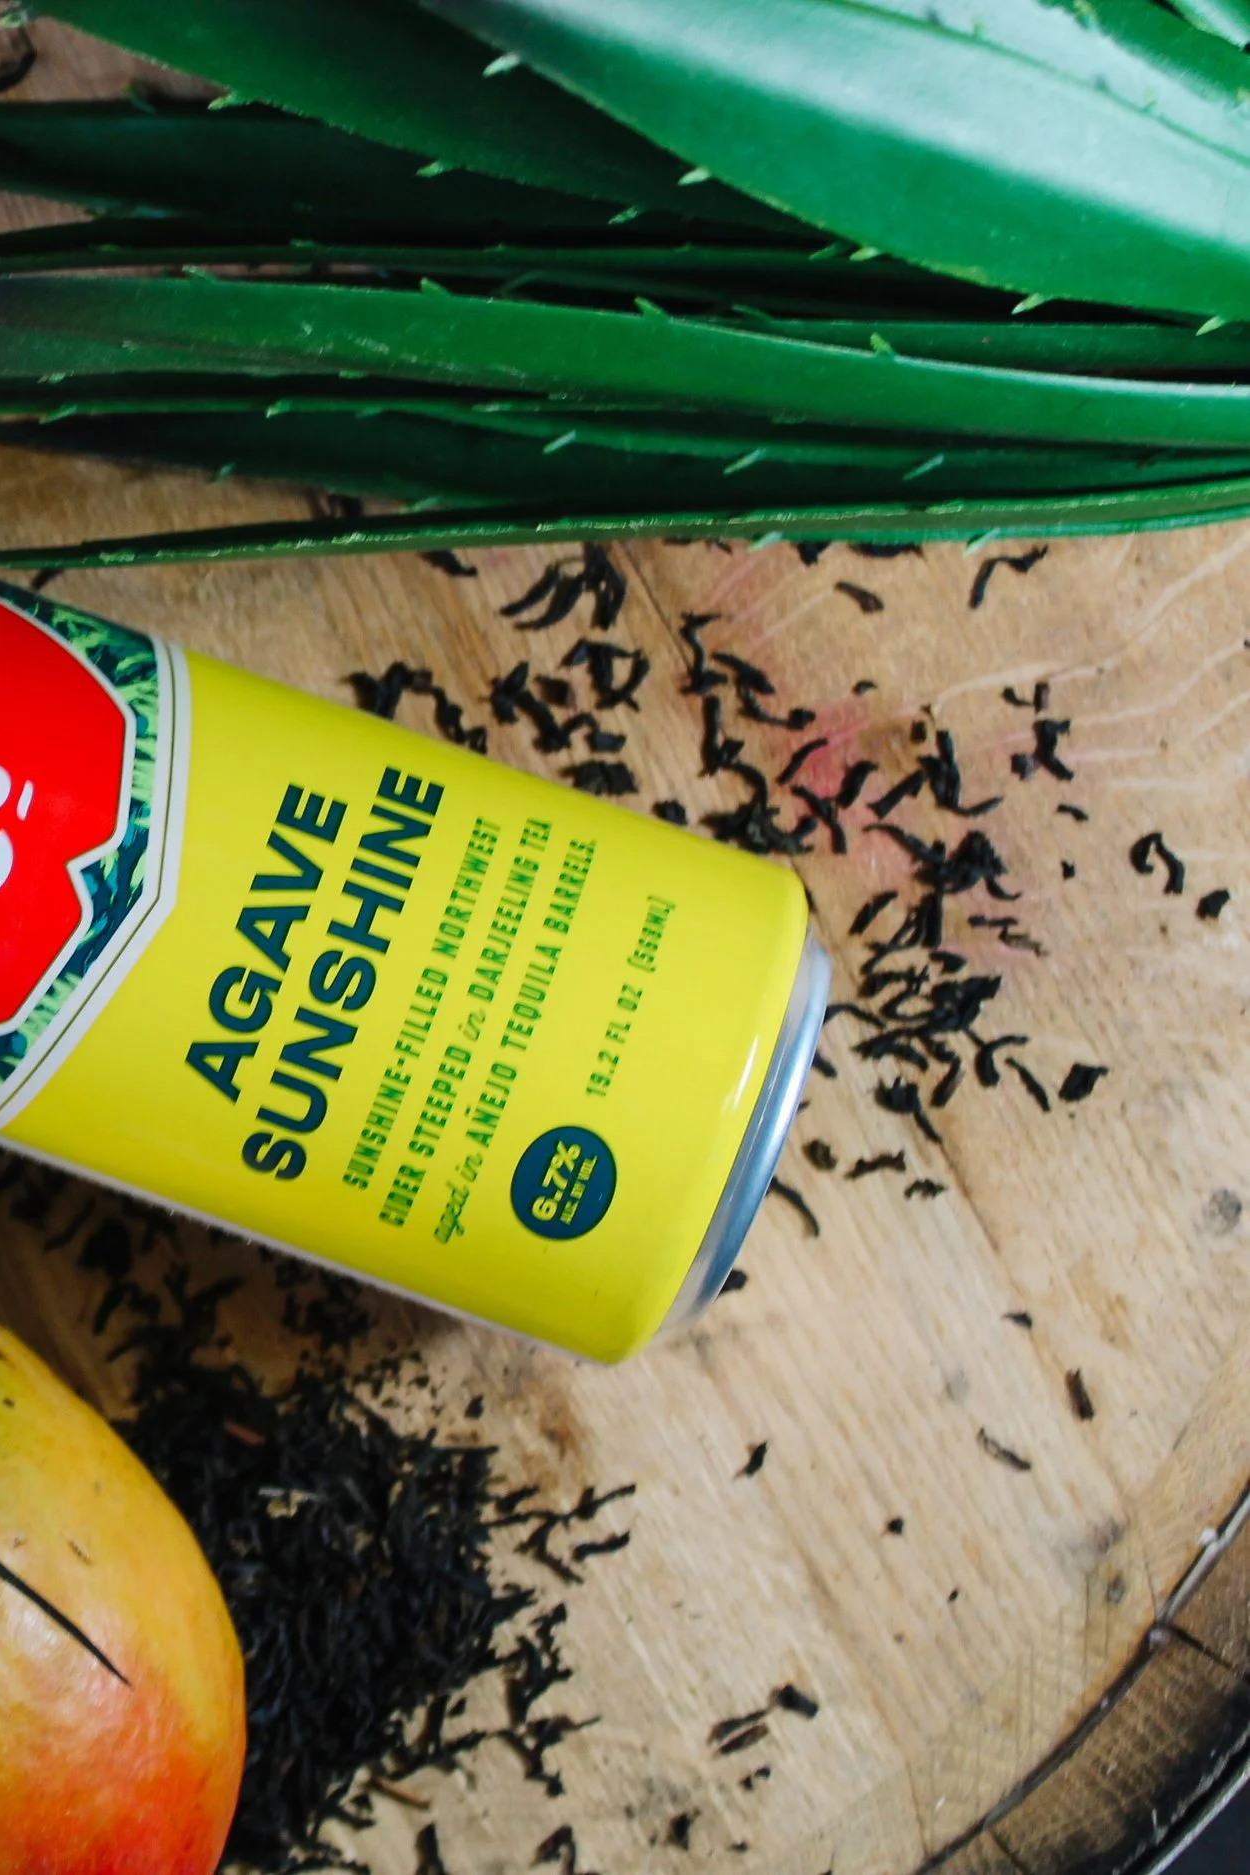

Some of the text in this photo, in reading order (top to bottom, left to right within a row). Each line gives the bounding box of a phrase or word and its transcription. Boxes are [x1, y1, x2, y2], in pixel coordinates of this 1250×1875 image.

[185, 783, 348, 1104] AGAVE
[241, 766, 445, 1181] SUNSHINE
[342, 816, 501, 1191] SUNSHINE-FILLED NORTHWEST
[379, 817, 552, 1228] CIDER STEEPED in DARJEELING TEA
[500, 943, 562, 1051] TEQUILA
[605, 1021, 632, 1044] FL
[616, 983, 643, 1012] OZ
[464, 1061, 518, 1149] AÑEJO
[586, 1050, 620, 1097] 19.2
[454, 1151, 483, 1183] in
[532, 1139, 581, 1222] 6.7%
[434, 1180, 470, 1244] aged
